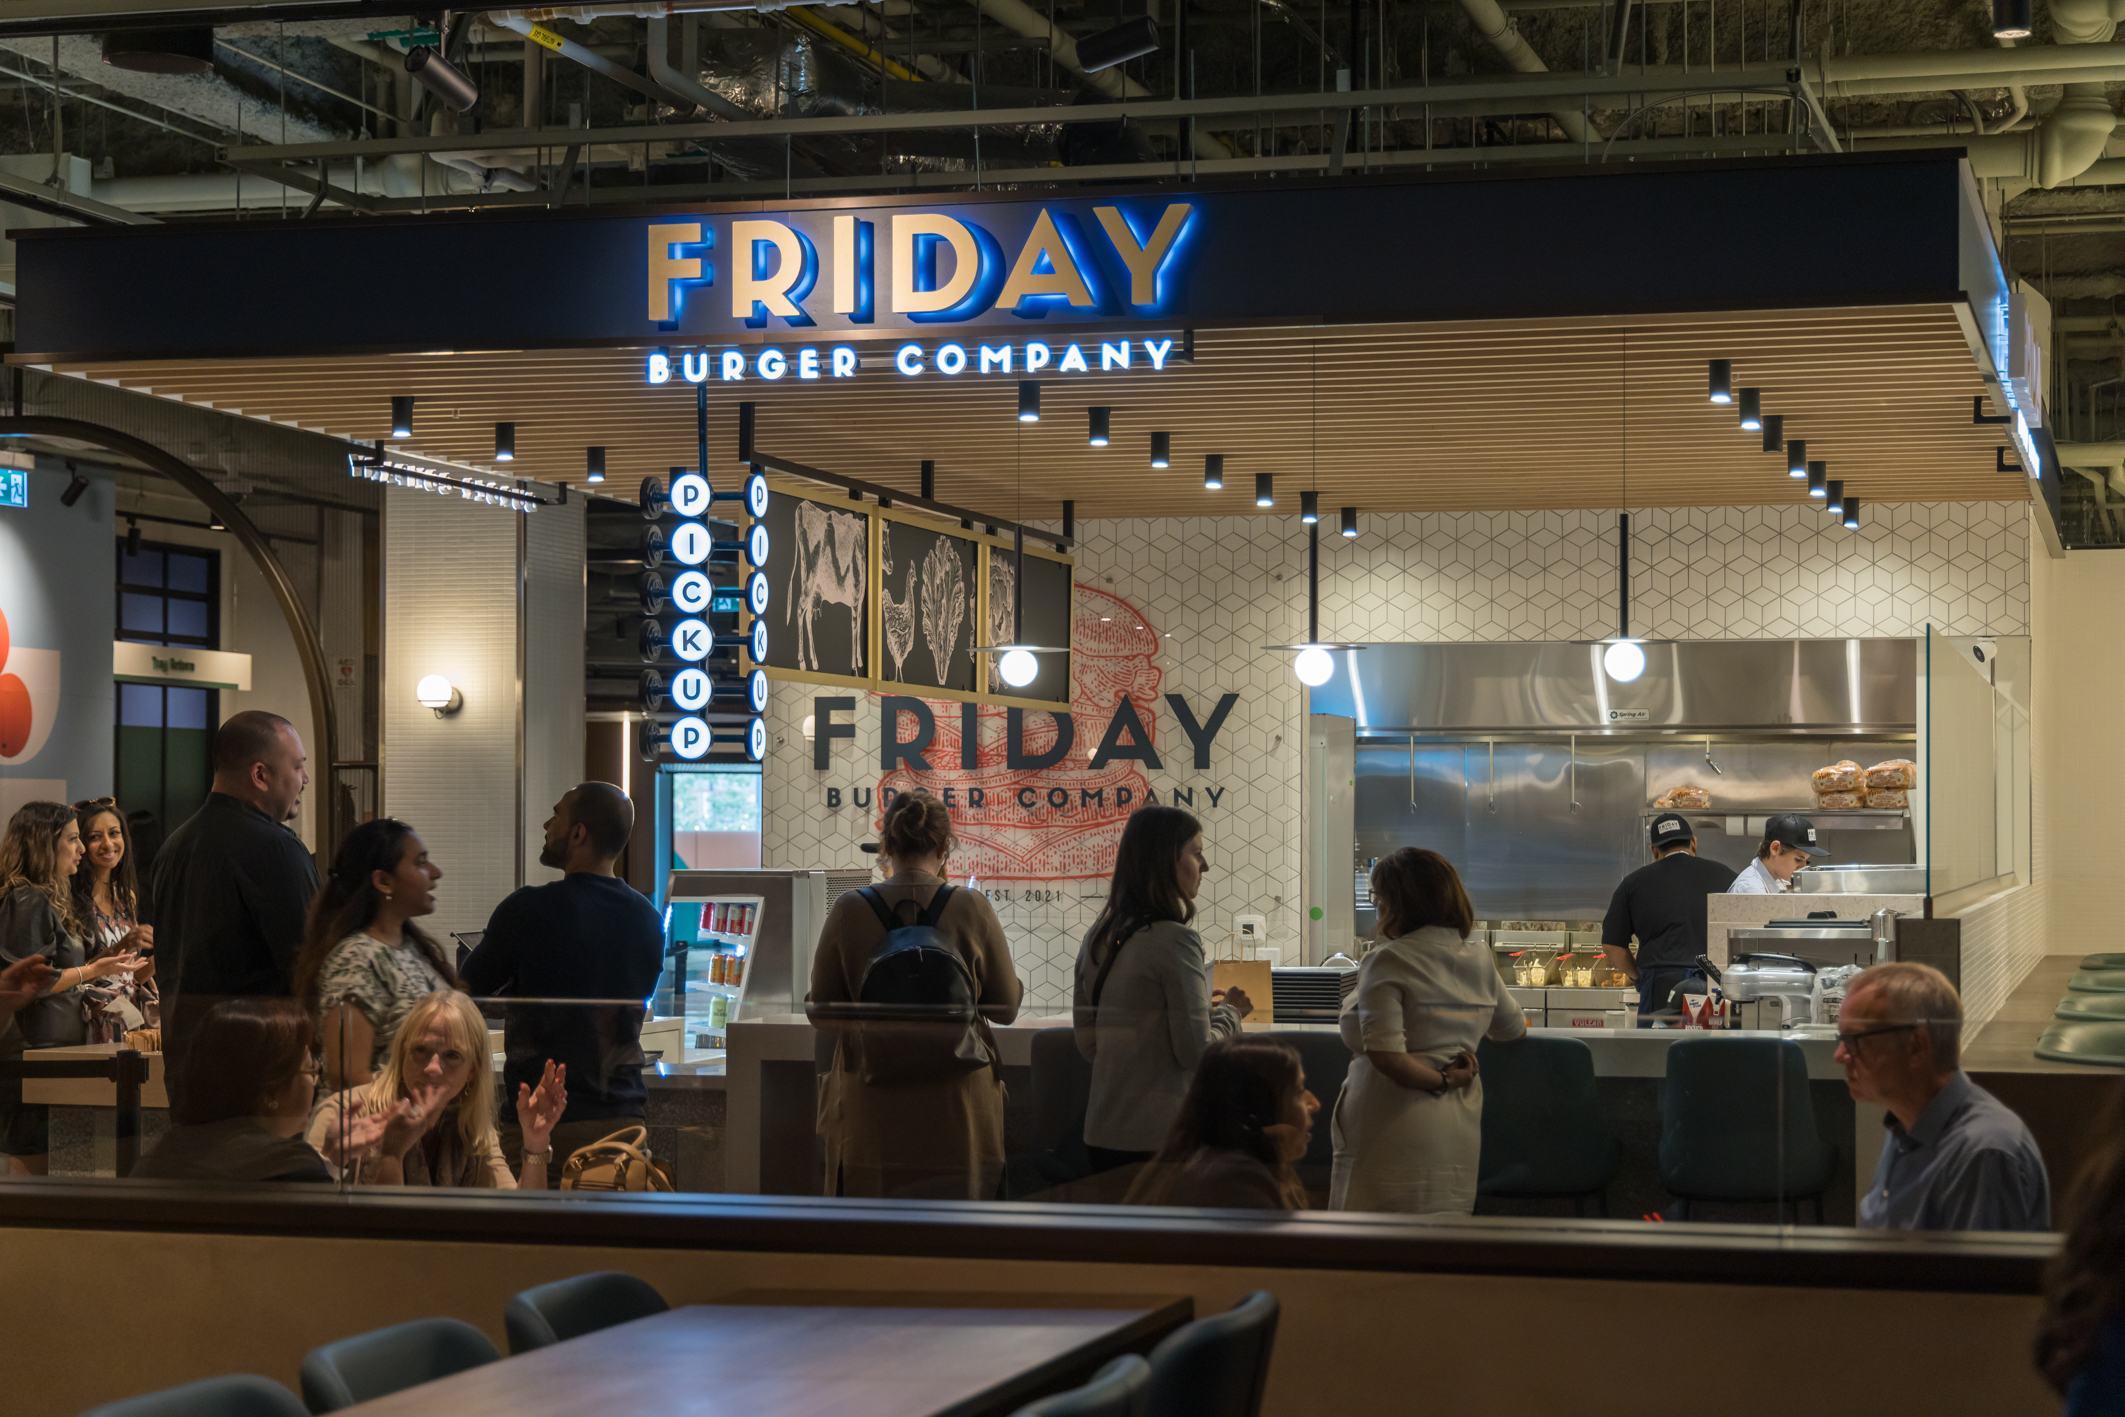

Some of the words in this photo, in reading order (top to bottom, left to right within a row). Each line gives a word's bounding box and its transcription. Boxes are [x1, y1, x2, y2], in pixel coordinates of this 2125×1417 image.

[647, 203, 1194, 322] FRIDAY
[648, 346, 858, 384] BURGER
[896, 338, 1173, 376] COMPANY
[814, 693, 1240, 771] FRIDAY
[827, 787, 985, 808] BUER
[985, 889, 1015, 902] EST.
[1025, 889, 1060, 902] 2021
